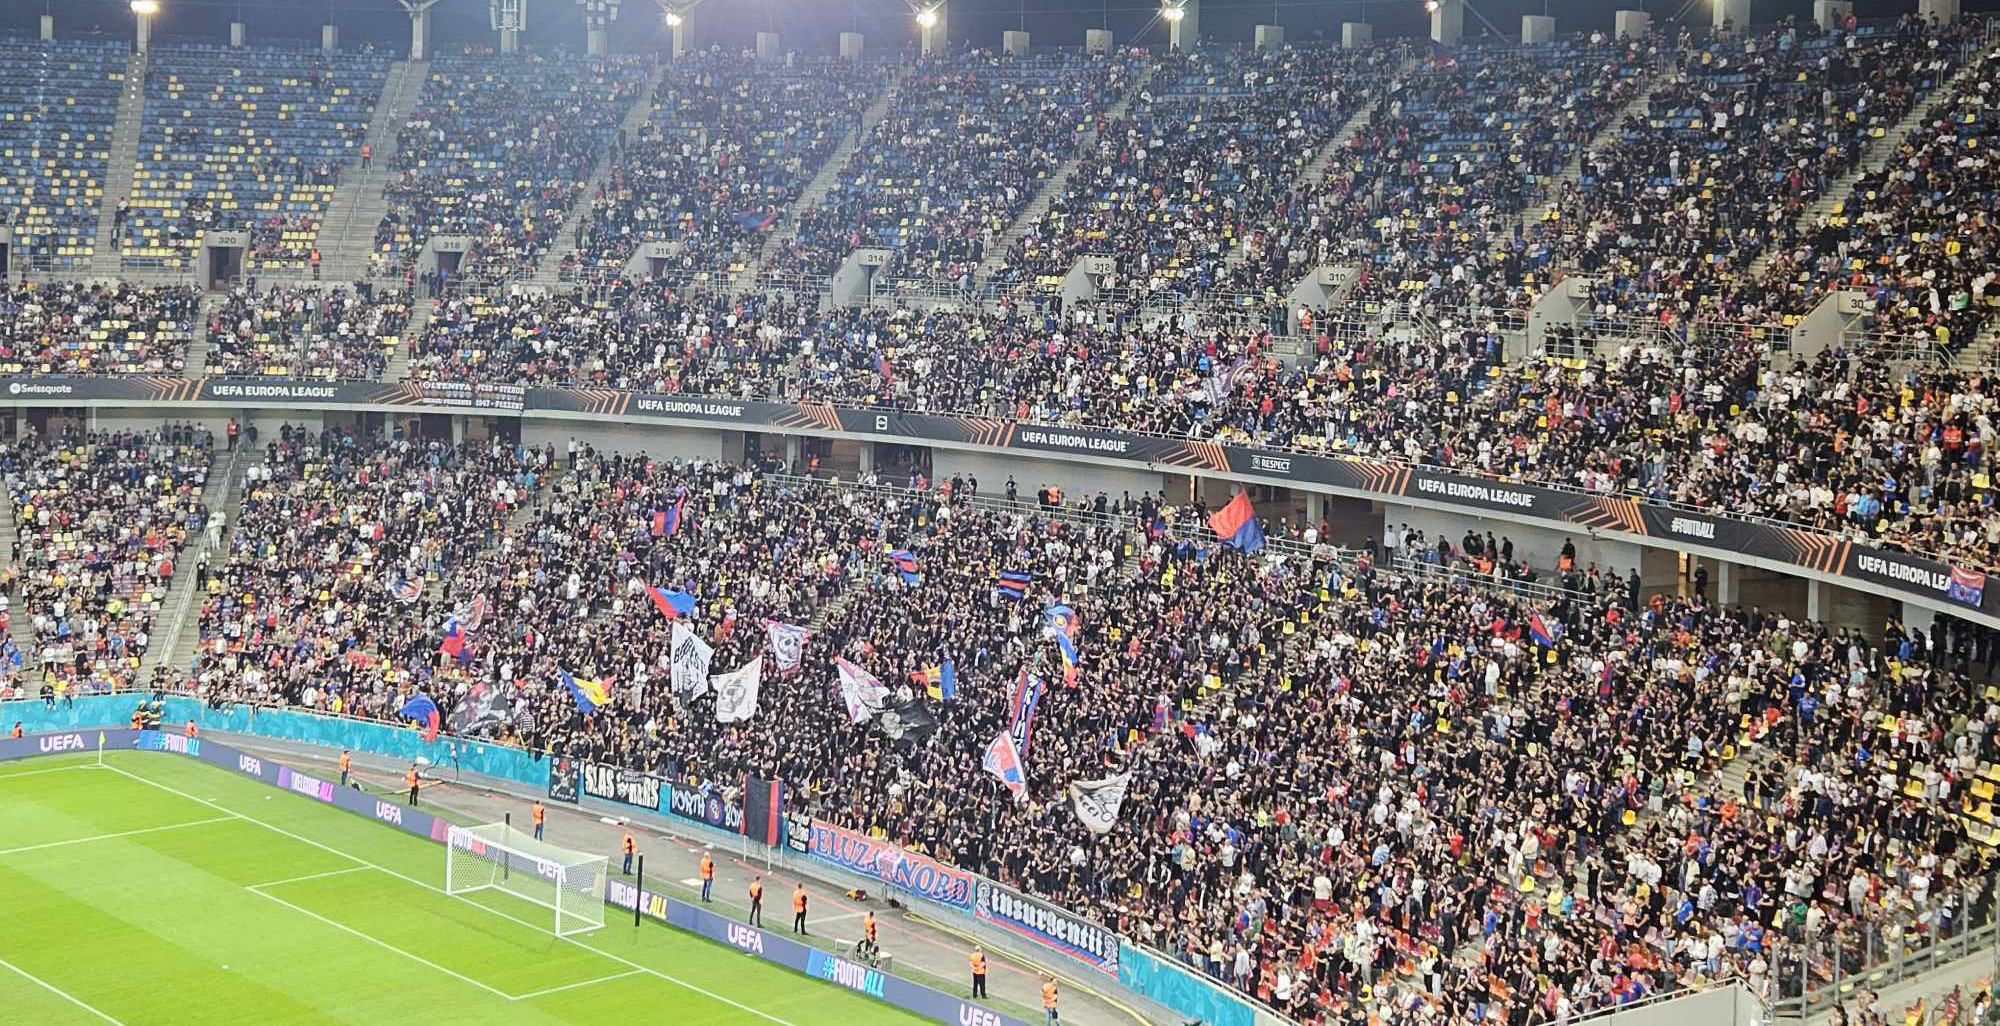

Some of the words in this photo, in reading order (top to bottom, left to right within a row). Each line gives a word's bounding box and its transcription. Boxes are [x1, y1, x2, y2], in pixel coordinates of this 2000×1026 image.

[867, 254, 884, 263] 314
[1094, 262, 1110, 271] 312
[1329, 273, 1346, 282] 310
[1578, 284, 1591, 294] 30
[1850, 298, 1864, 309] 30
[21, 384, 72, 394] Swissquote
[213, 385, 243, 396] UEFA
[245, 386, 290, 397] EUROPA
[292, 387, 336, 398] LEAGUE
[638, 399, 664, 411] UEFA
[665, 401, 703, 414] EUROPA
[704, 404, 742, 417] LEAGUE
[1022, 431, 1048, 444] UEFA
[1049, 433, 1087, 449] EUROPA
[1089, 437, 1127, 453] LEAGUE
[1261, 458, 1290, 471] RESPECT
[1418, 478, 1446, 495] UEFA
[1447, 482, 1489, 501] EUROPA
[1490, 488, 1533, 507] LEAGUE
[1858, 554, 1887, 575] UEFA
[1888, 561, 1931, 587] EUROPA
[1932, 573, 1952, 592] LEA
[40, 733, 84, 752] UEFA
[239, 754, 262, 776] UEFA
[376, 800, 402, 826] UEFA
[671, 786, 705, 818] NORTH
[724, 803, 744, 828] BOY
[537, 858, 567, 884] UEFA
[649, 894, 668, 919] ALL
[727, 922, 764, 954] UEFA
[823, 956, 886, 999] #FOOTBALL
